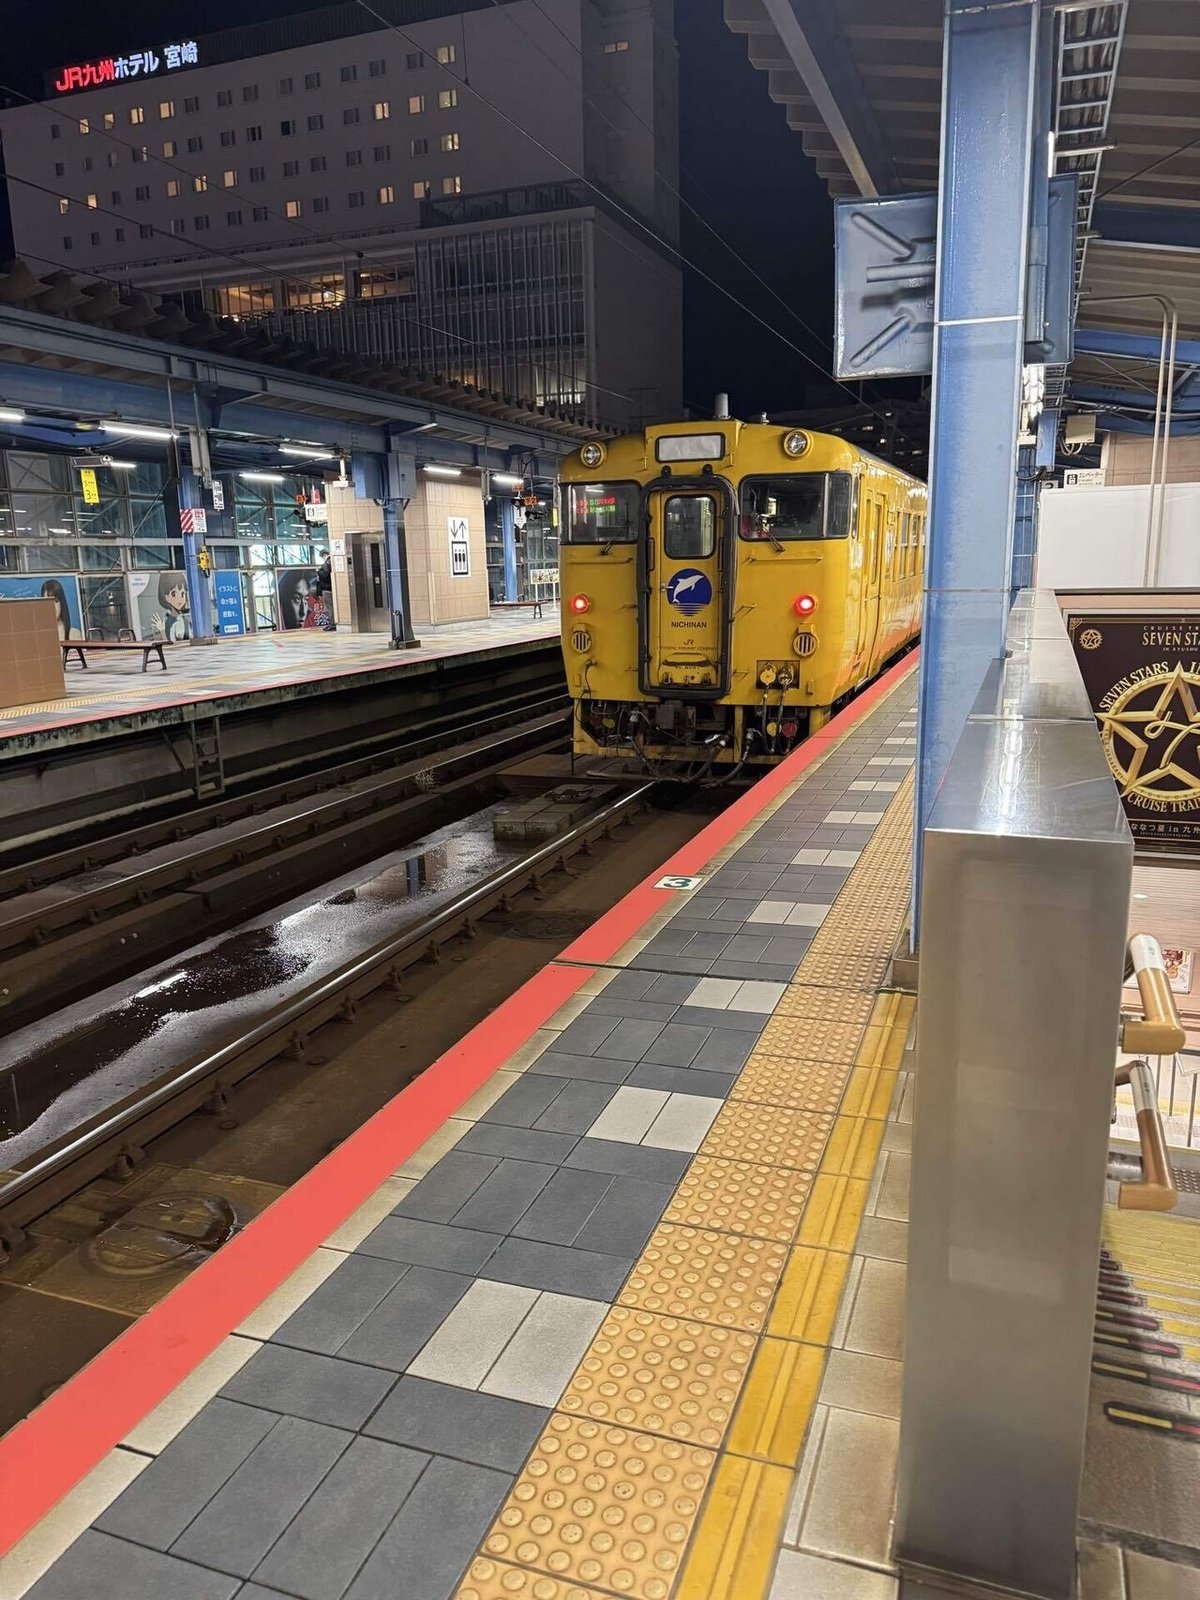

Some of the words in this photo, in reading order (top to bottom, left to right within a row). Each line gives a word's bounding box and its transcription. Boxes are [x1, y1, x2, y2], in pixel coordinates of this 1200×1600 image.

[56, 51, 159, 91] JR九州ホテル
[164, 41, 198, 69] 宮崎
[1142, 631, 1182, 646] SEVEN
[1184, 631, 1200, 646] ST
[1099, 676, 1132, 711] SEVEN
[1130, 661, 1169, 684] STARS
[1127, 792, 1168, 813] CRUISE
[663, 877, 692, 888] 3
